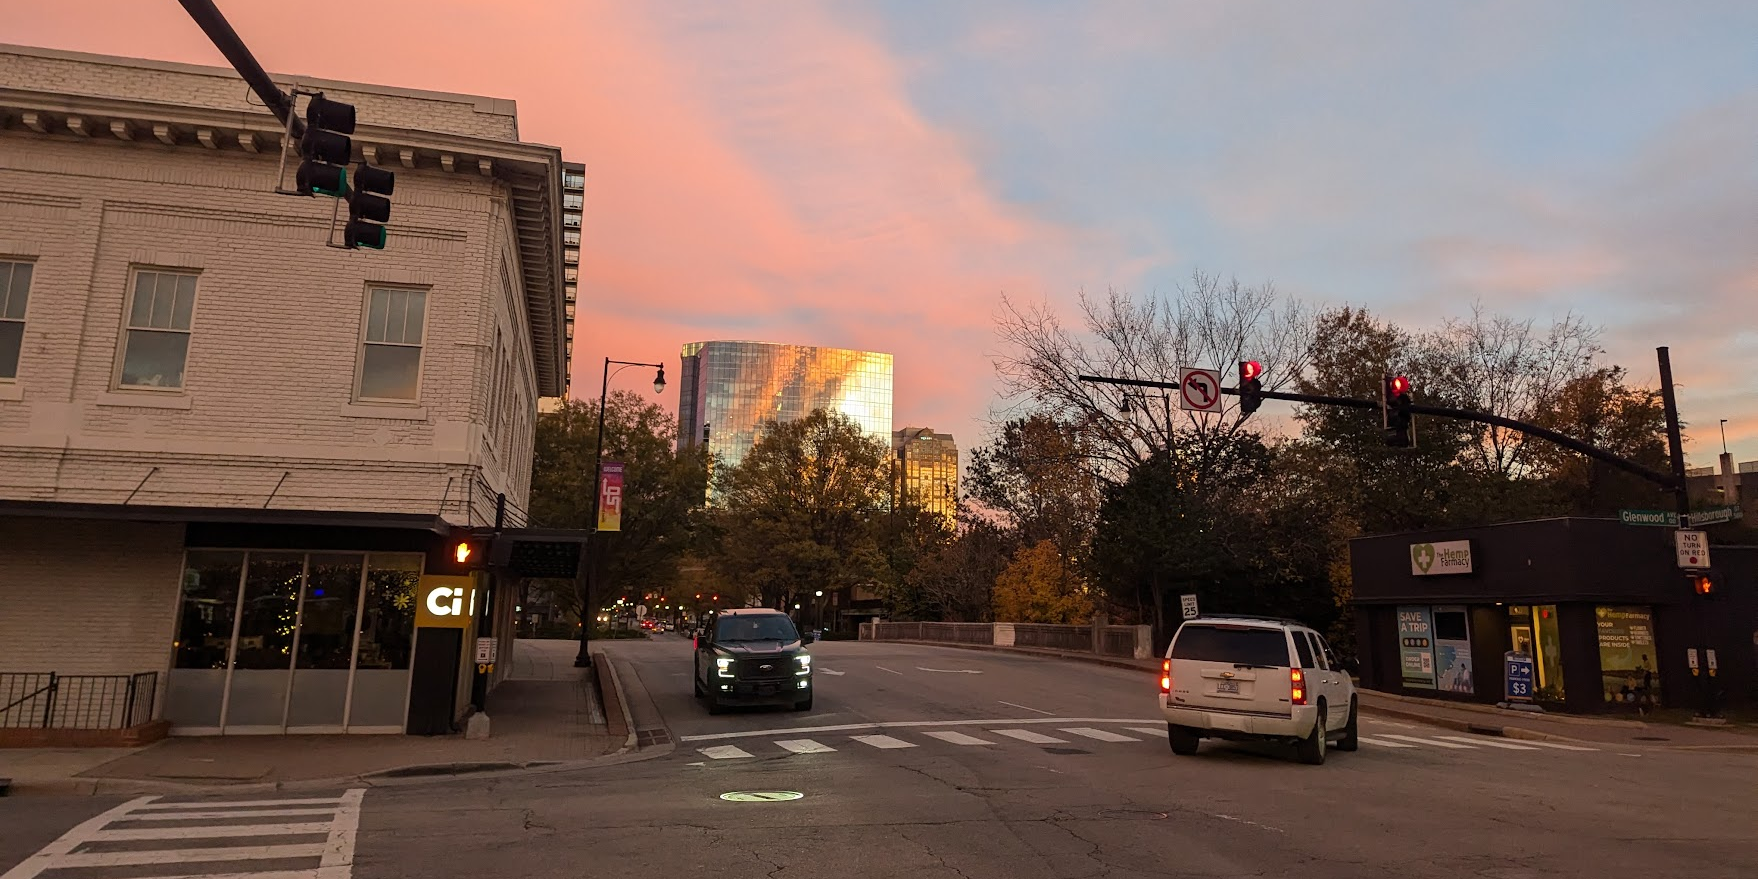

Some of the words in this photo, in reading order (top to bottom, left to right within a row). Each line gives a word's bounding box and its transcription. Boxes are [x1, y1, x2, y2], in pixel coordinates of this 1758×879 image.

[1622, 510, 1665, 523] Glenwood
[1690, 506, 1733, 524] Hillsborough
[1443, 548, 1469, 559] Hemp
[1440, 557, 1470, 568] Farmacy
[1184, 606, 1197, 616] 25
[1400, 612, 1422, 621] SAVE
[1401, 623, 1407, 632] A
[1409, 622, 1428, 632] TRIP
[1511, 665, 1518, 674] P
[1513, 682, 1527, 695] $3
